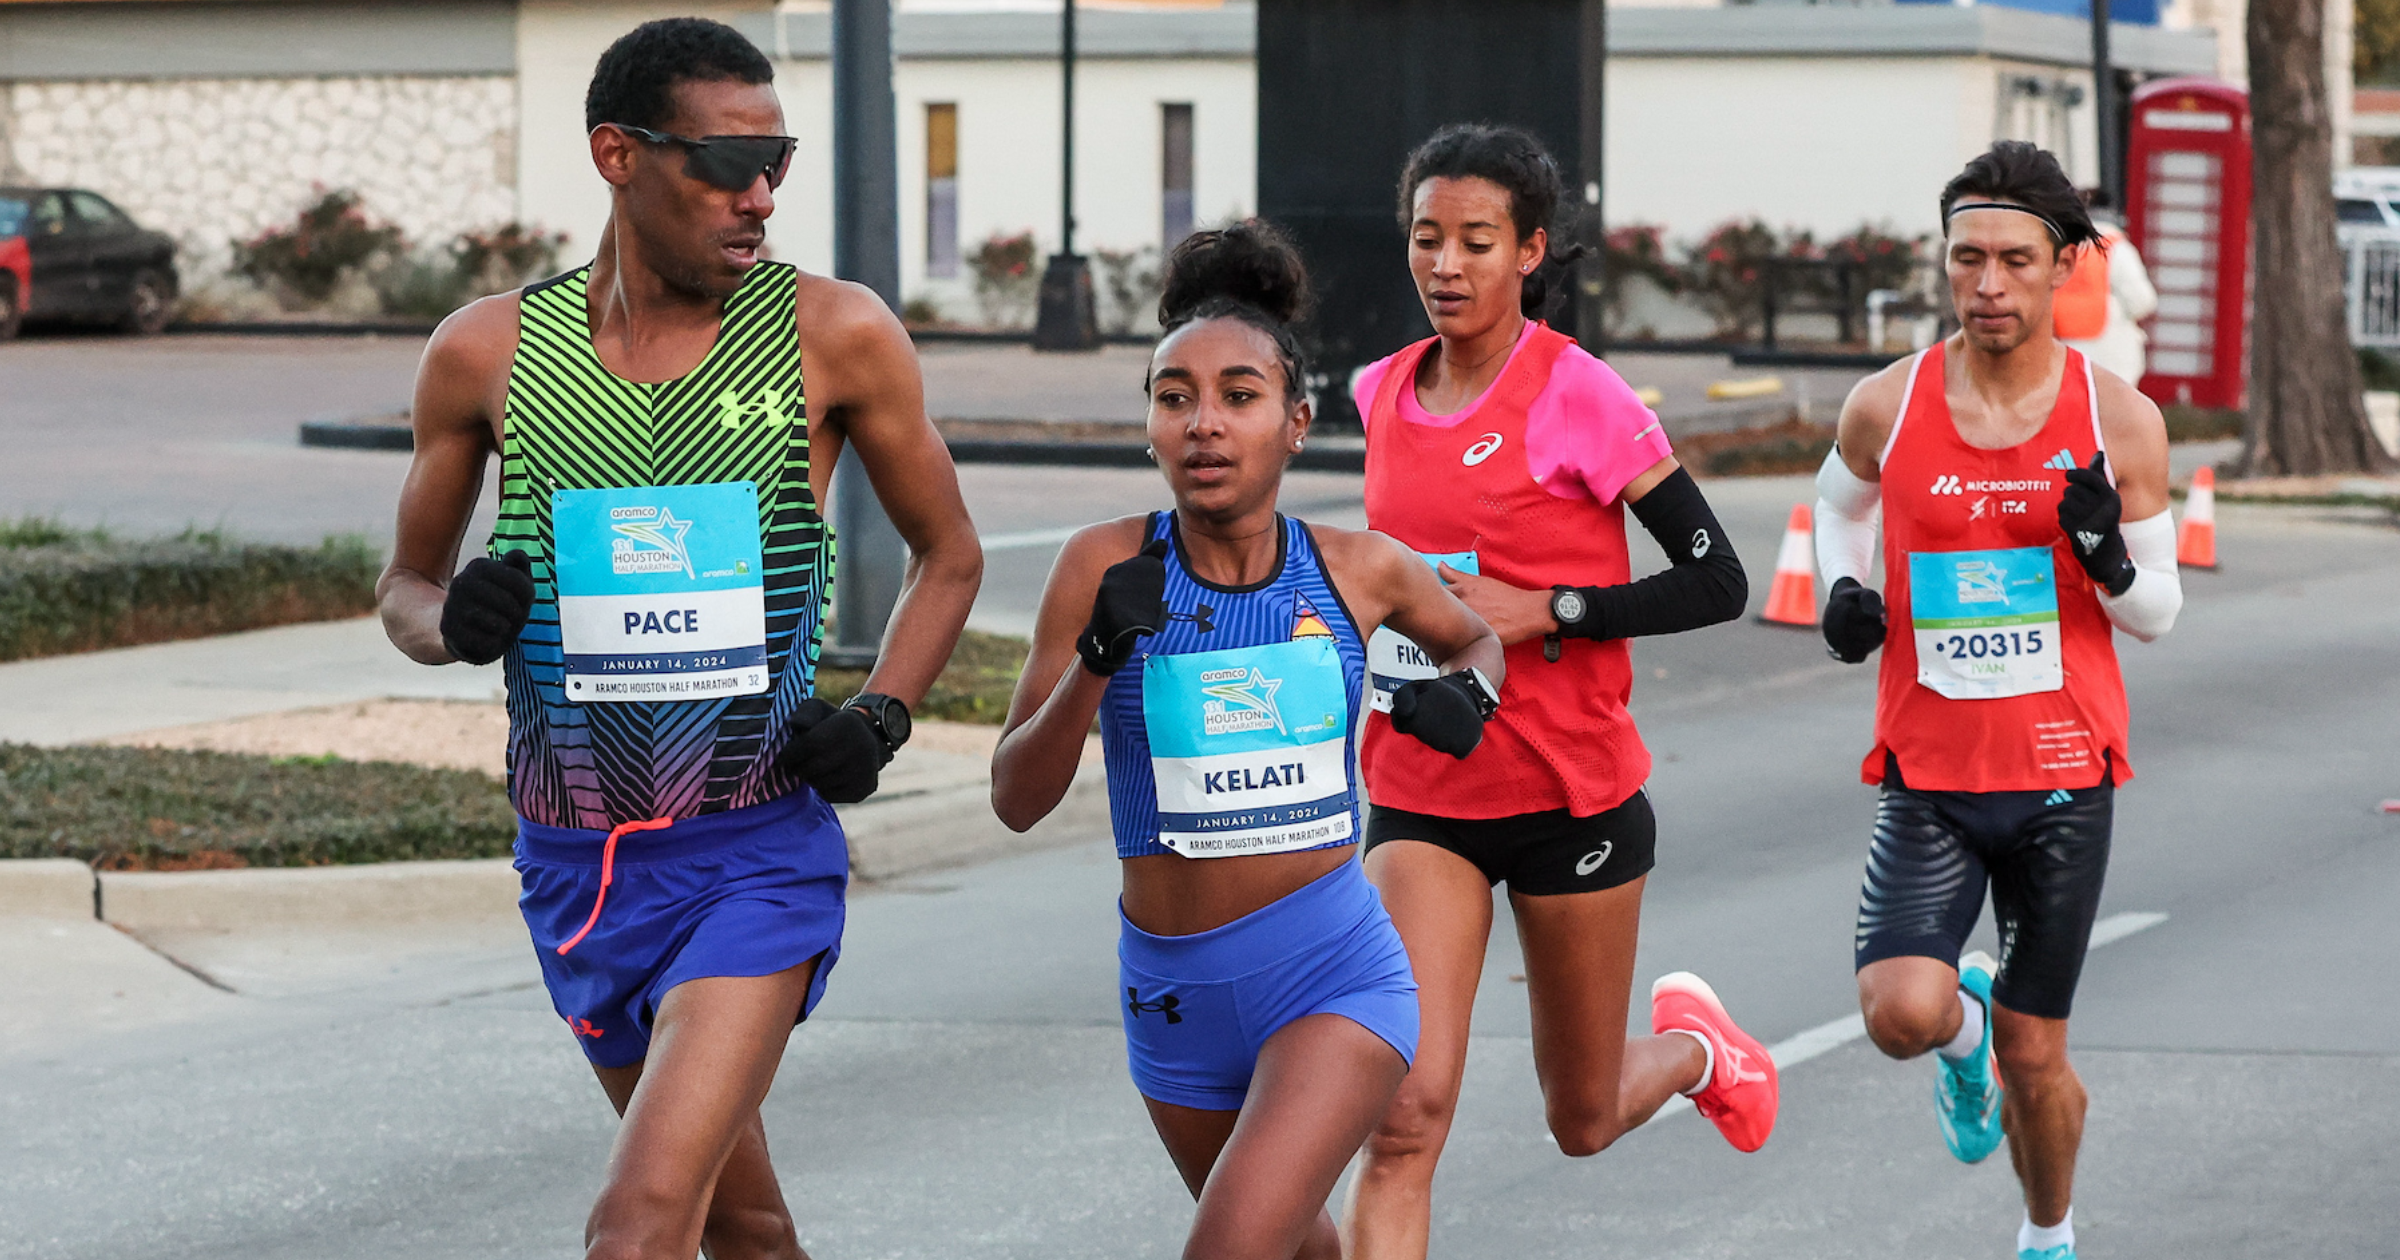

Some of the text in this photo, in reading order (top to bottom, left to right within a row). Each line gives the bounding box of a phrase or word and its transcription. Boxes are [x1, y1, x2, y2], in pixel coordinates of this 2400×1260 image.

[1966, 480, 2051, 492] MICROBIOTFIT
[612, 508, 656, 518] aramco
[614, 552, 670, 563] HOUSTON
[615, 562, 681, 573] HALF MARATHON
[702, 570, 734, 578] aramco
[624, 609, 699, 635] PACE
[602, 656, 727, 670] JANUARY 14, 2024
[1202, 669, 1246, 680] aramco
[595, 674, 760, 694] ARAMCO HOUSTON HALF MARATHON 32
[1206, 710, 1261, 724] HOUSTON
[1207, 720, 1272, 733] HALF MARATHON
[1294, 724, 1323, 733] aramco
[1204, 763, 1305, 794] KELATI
[1196, 806, 1320, 828] JANUARY 14, 2024
[1189, 840, 1223, 850] ARAMCO
[1225, 837, 1264, 849] HOUSTON
[1265, 833, 1287, 846] HALF
[1288, 826, 1330, 842] MARATHON
